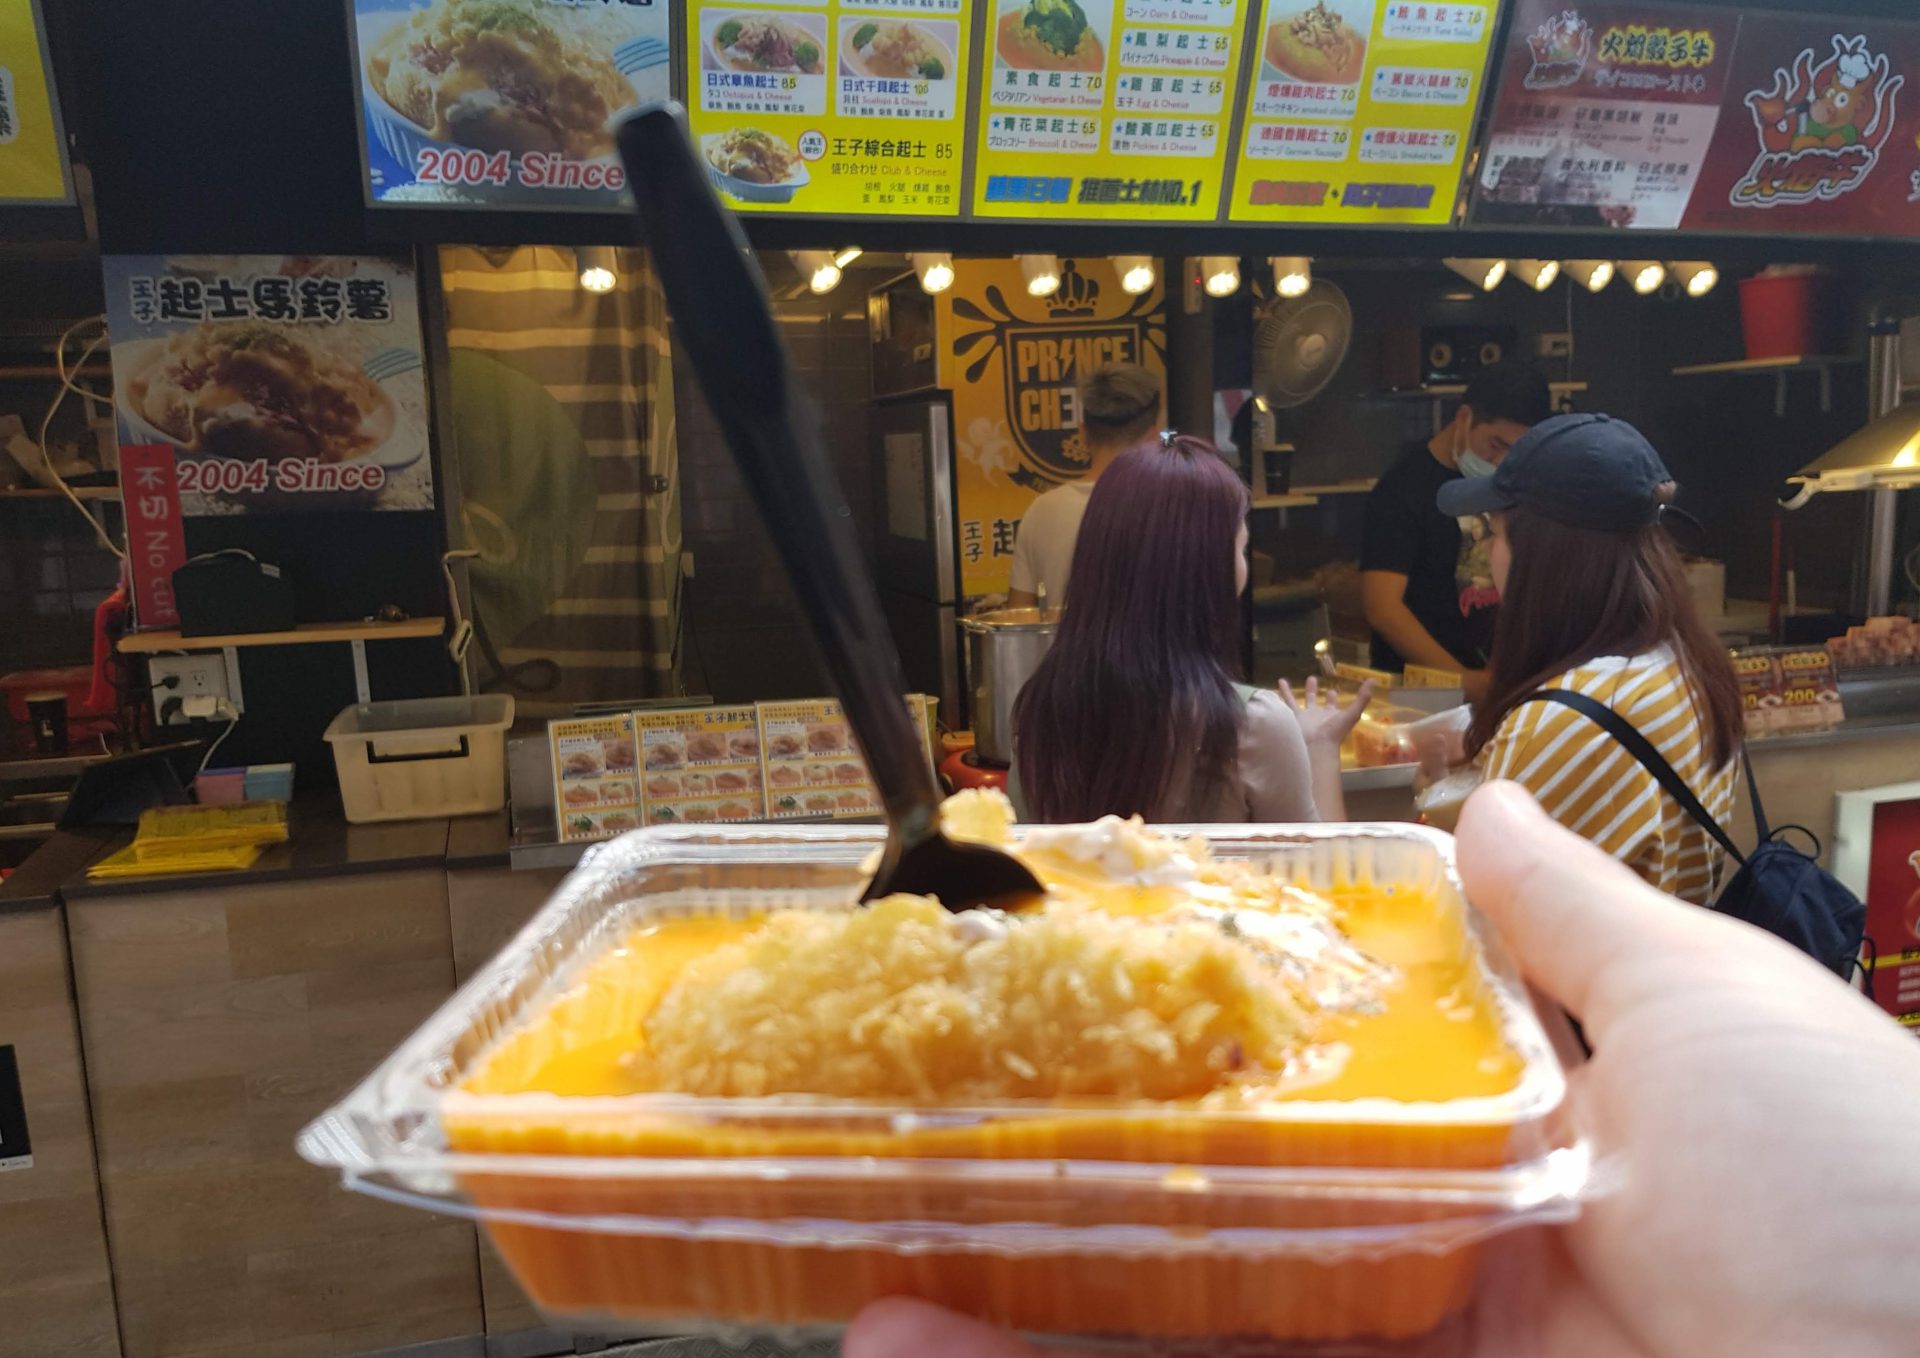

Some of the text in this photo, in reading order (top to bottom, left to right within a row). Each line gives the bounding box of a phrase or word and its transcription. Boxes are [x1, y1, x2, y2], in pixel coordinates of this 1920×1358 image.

[1215, 37, 1228, 50] 65
[781, 78, 797, 90] 85
[1006, 71, 1102, 89] 素食起士 70
[1209, 81, 1222, 93] 65
[914, 84, 929, 95] 100
[1004, 117, 1096, 134] 青花菜起士 65
[1201, 125, 1215, 137] 65
[832, 138, 953, 159] 王子綜合起士 85
[418, 150, 625, 189] 2004 Since
[130, 277, 390, 322] 王子 起士馬鈴薯
[176, 459, 384, 492] 2004 Since
[962, 520, 985, 562] 王子
[1783, 687, 1815, 705] 200
